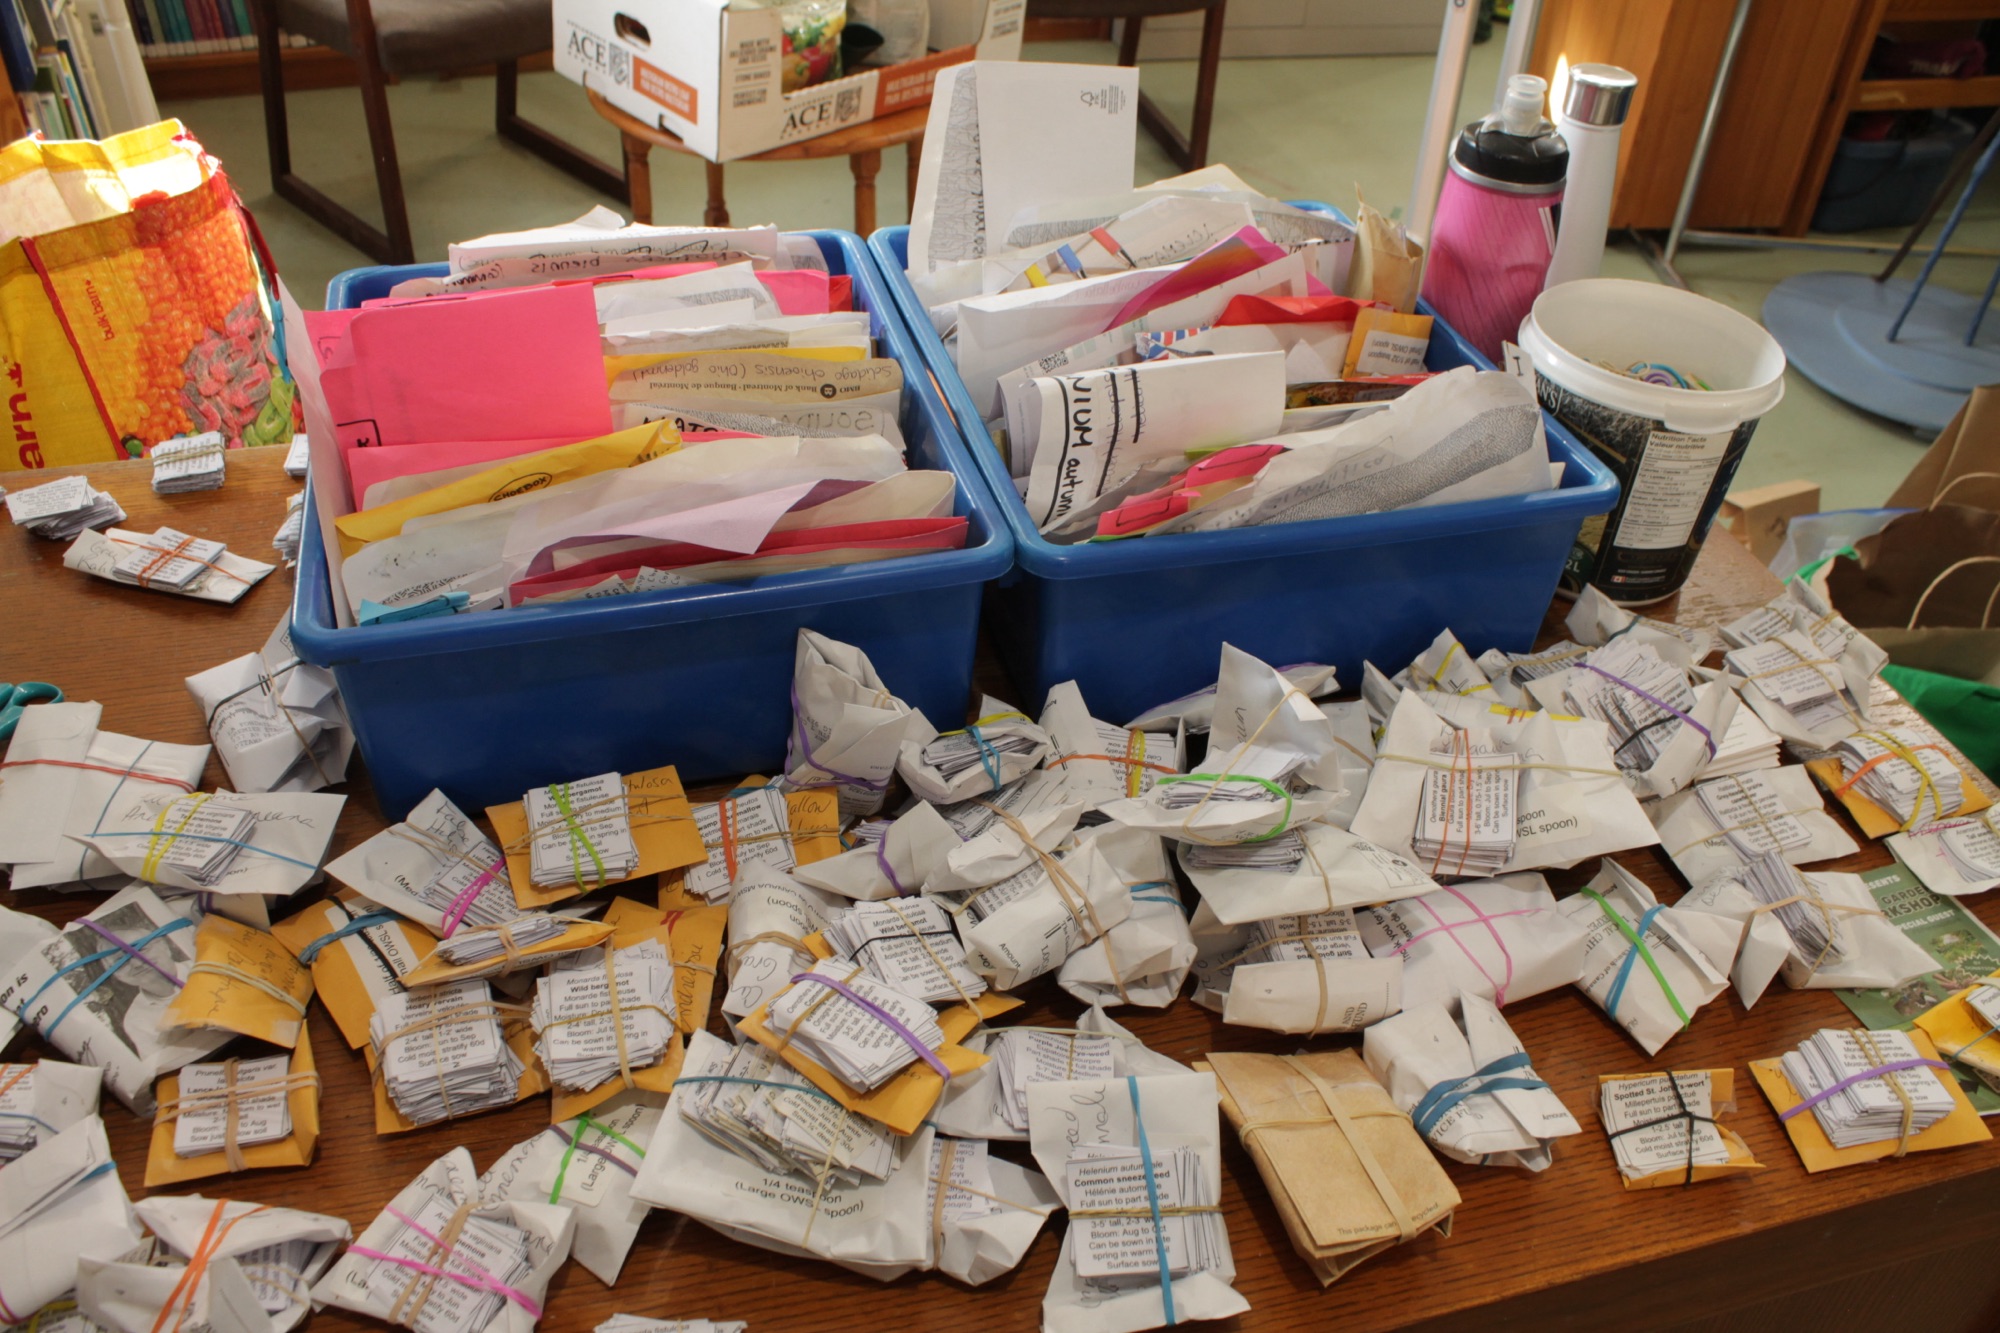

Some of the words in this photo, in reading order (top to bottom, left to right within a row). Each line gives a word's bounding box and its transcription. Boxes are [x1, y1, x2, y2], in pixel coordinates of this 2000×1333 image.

[568, 29, 607, 68] ACE
[782, 99, 831, 133] ACE
[86, 284, 104, 316] barn
[96, 315, 115, 342] bulk
[756, 363, 825, 379] ohioensis
[834, 364, 892, 381] Solidago
[696, 382, 707, 390] de
[709, 382, 737, 392] Banque
[743, 383, 781, 393] Montreal
[783, 384, 793, 392] of
[795, 384, 817, 393] Bank
[839, 385, 861, 393] BMO
[1649, 440, 1674, 450] Valeur
[1675, 442, 1705, 450] nutritive
[1651, 432, 1685, 443] Nutrition
[1686, 435, 1707, 444] Facts
[594, 806, 622, 815] medium
[1539, 816, 1579, 835] spoon)
[1926, 909, 1956, 923] GUEST
[379, 929, 399, 957] OWSL
[15, 972, 28, 988] is
[571, 985, 589, 994] Wild
[590, 980, 630, 991] bergot
[564, 993, 598, 1003] Monarde
[559, 1004, 573, 1012] Full
[575, 1002, 590, 1010] sun
[460, 1033, 477, 1043] Sep
[553, 1038, 569, 1046] Can
[583, 1036, 604, 1045] sown
[1028, 1036, 1053, 1047] Purple
[397, 1054, 417, 1063] Cold
[469, 1039, 486, 1048] 60d
[582, 1044, 604, 1053] warm
[451, 1052, 467, 1061] sow
[1618, 1078, 1658, 1090] Hypericum
[1658, 1072, 1699, 1085] puctatum
[1614, 1090, 1644, 1101] Spotted
[1646, 1087, 1657, 1096] St.
[1658, 1080, 1706, 1094] Joh's-wort
[1624, 1110, 1638, 1119] Full
[1638, 1108, 1653, 1116] sun
[1662, 1103, 1677, 1114] part
[1635, 1145, 1652, 1154] Cold
[1653, 1142, 1674, 1151] moist
[1655, 1148, 1685, 1159] Surface
[579, 1155, 607, 1192] (Large
[1078, 1164, 1118, 1177] Helenium
[1119, 1161, 1163, 1175] autumle
[761, 1178, 781, 1189] 1/4
[1074, 1176, 1115, 1188] Common
[1116, 1170, 1170, 1184] sneezeeed
[1085, 1184, 1117, 1198] Hélénie
[734, 1180, 776, 1199] (Large
[824, 1200, 864, 1219] spoon)
[1080, 1199, 1096, 1209] Full
[1098, 1199, 1113, 1208] sun
[1125, 1195, 1142, 1207] part
[1091, 1219, 1108, 1229] 3-5'
[1353, 1224, 1383, 1235] package
[1410, 1202, 1439, 1222] ecycled
[1091, 1229, 1120, 1240] Bloom:
[1122, 1227, 1140, 1239] Aug
[456, 1239, 486, 1260] nemone
[1088, 1240, 1106, 1250] Can
[1107, 1238, 1119, 1249] be
[1121, 1238, 1144, 1248] sown
[1092, 1250, 1119, 1262] spring
[1130, 1247, 1154, 1258] warm
[1106, 1259, 1140, 1270] Surface
[1141, 1257, 1159, 1268] sow
